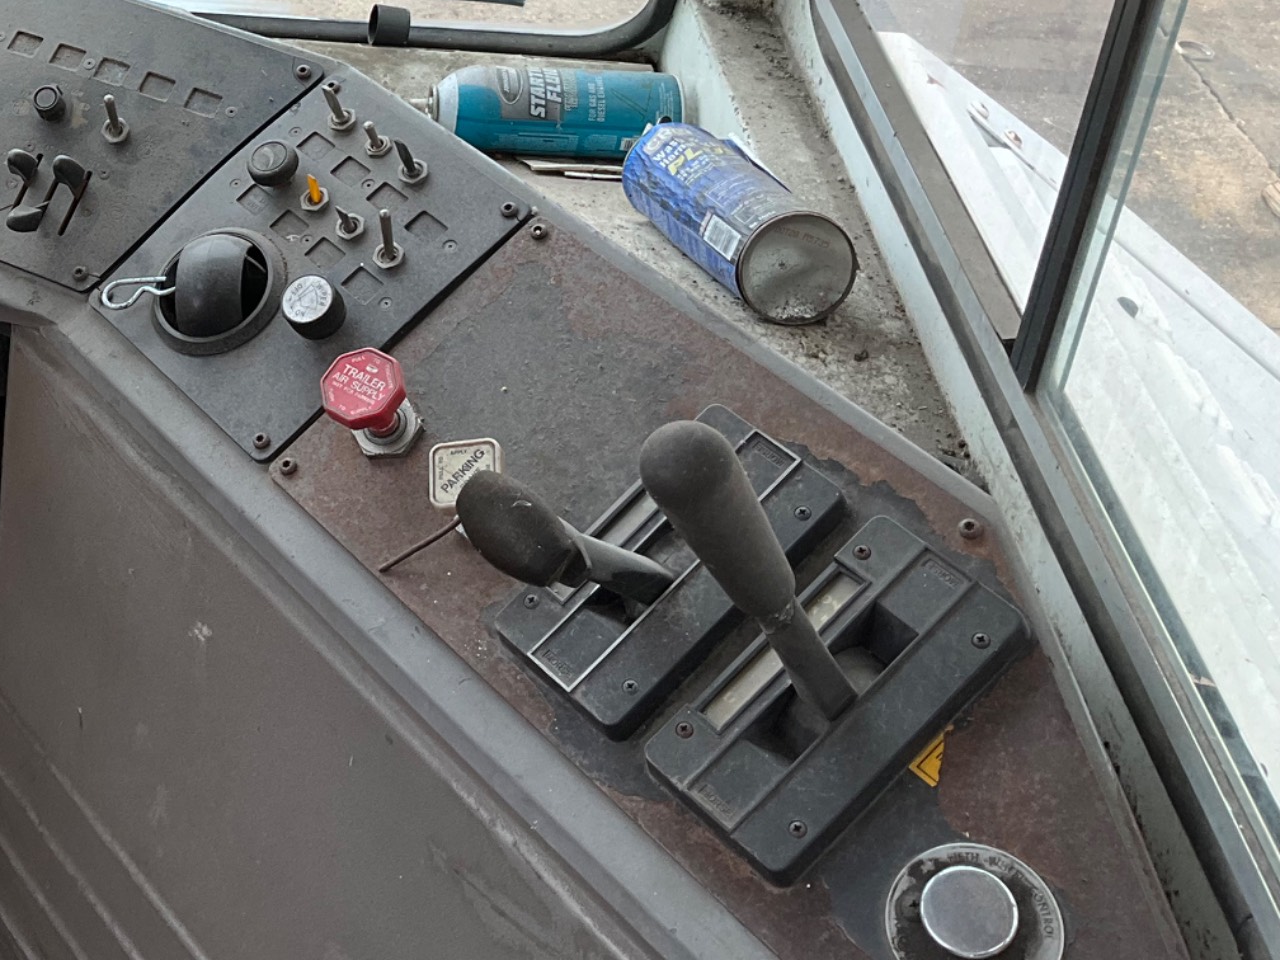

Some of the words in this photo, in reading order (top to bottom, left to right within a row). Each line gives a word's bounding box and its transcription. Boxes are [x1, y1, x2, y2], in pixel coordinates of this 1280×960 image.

[529, 67, 546, 118] STARTI
[588, 94, 597, 108] GAS
[587, 110, 597, 122] FOR
[596, 99, 606, 122] DIESEL
[331, 371, 350, 385] AIR
[350, 379, 386, 402] SUPPLY
[342, 363, 387, 392] TRAILER
[440, 448, 486, 494] PARKING
